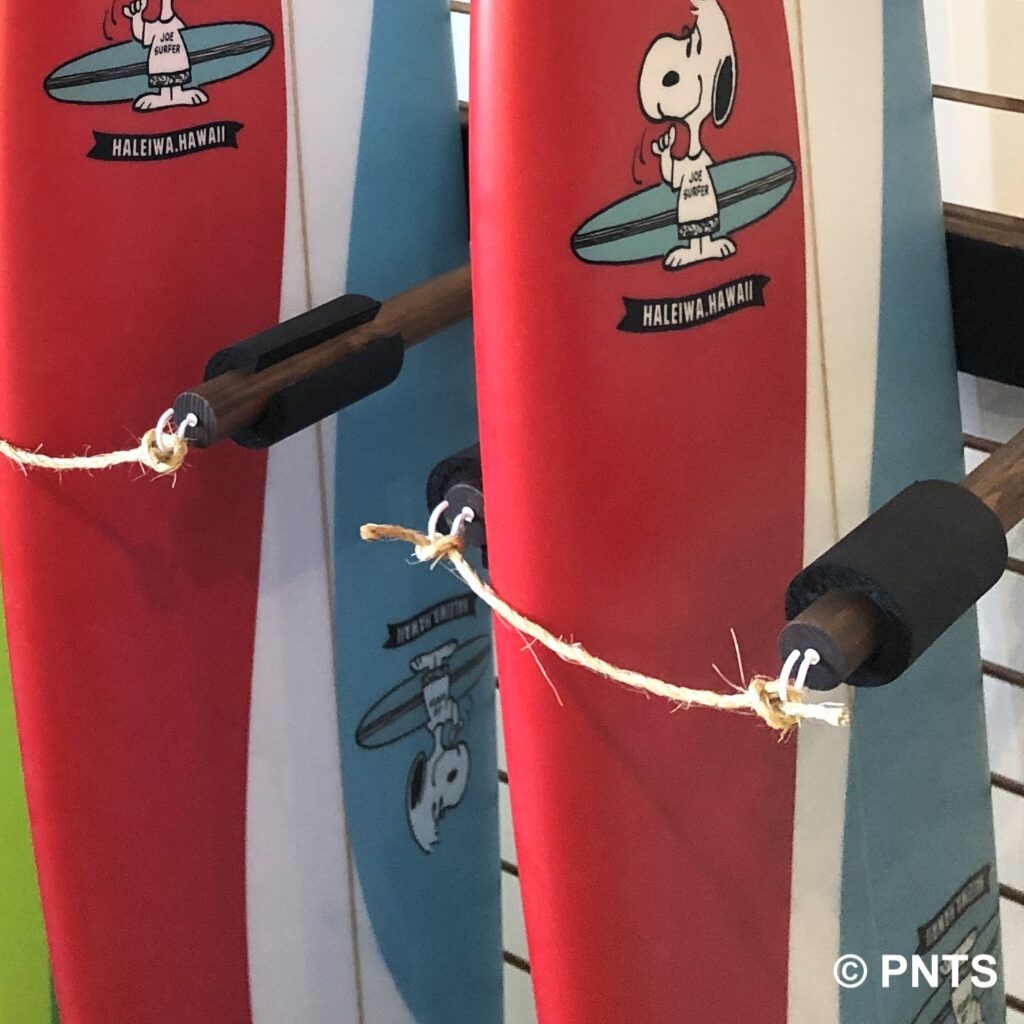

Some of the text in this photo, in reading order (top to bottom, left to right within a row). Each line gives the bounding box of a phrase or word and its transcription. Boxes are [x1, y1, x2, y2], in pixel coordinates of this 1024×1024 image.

[160, 31, 174, 42] JOE
[154, 44, 181, 56] SURFER
[112, 125, 226, 157] HALEIWA.HAWAII
[689, 170, 703, 183] JOE
[683, 184, 709, 200] SURFER
[642, 280, 754, 327] HALEIWA.HAWAII
